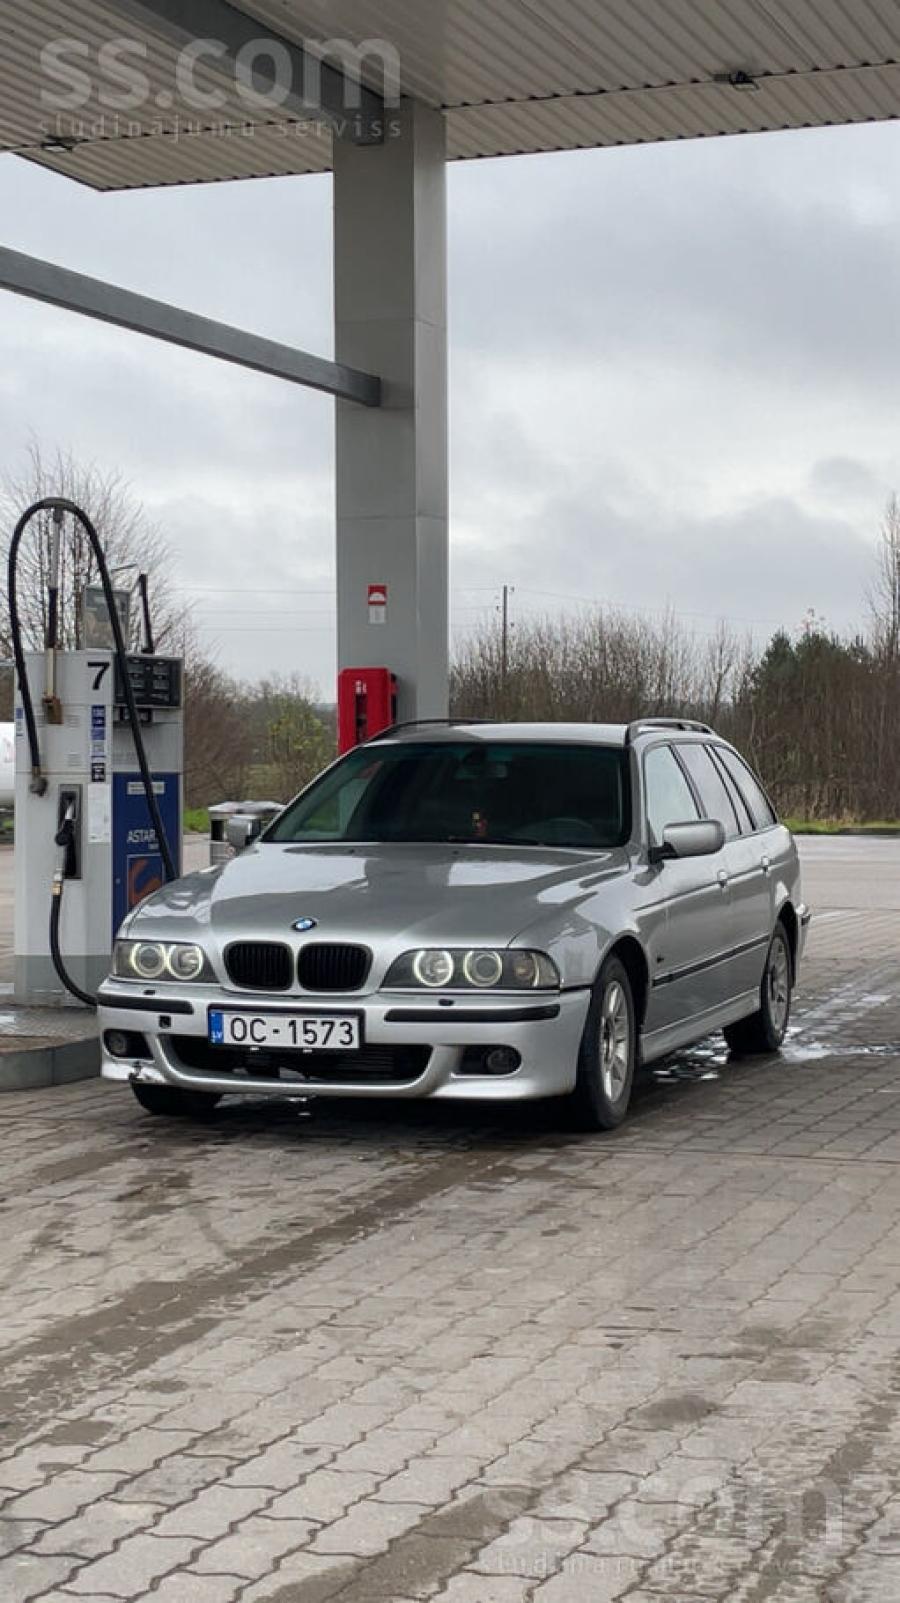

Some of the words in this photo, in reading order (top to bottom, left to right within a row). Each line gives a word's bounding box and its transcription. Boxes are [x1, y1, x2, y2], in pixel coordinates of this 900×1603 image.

[87, 661, 110, 690] 7
[127, 828, 158, 843] ASTAR
[230, 1017, 354, 1046] OC-1573
